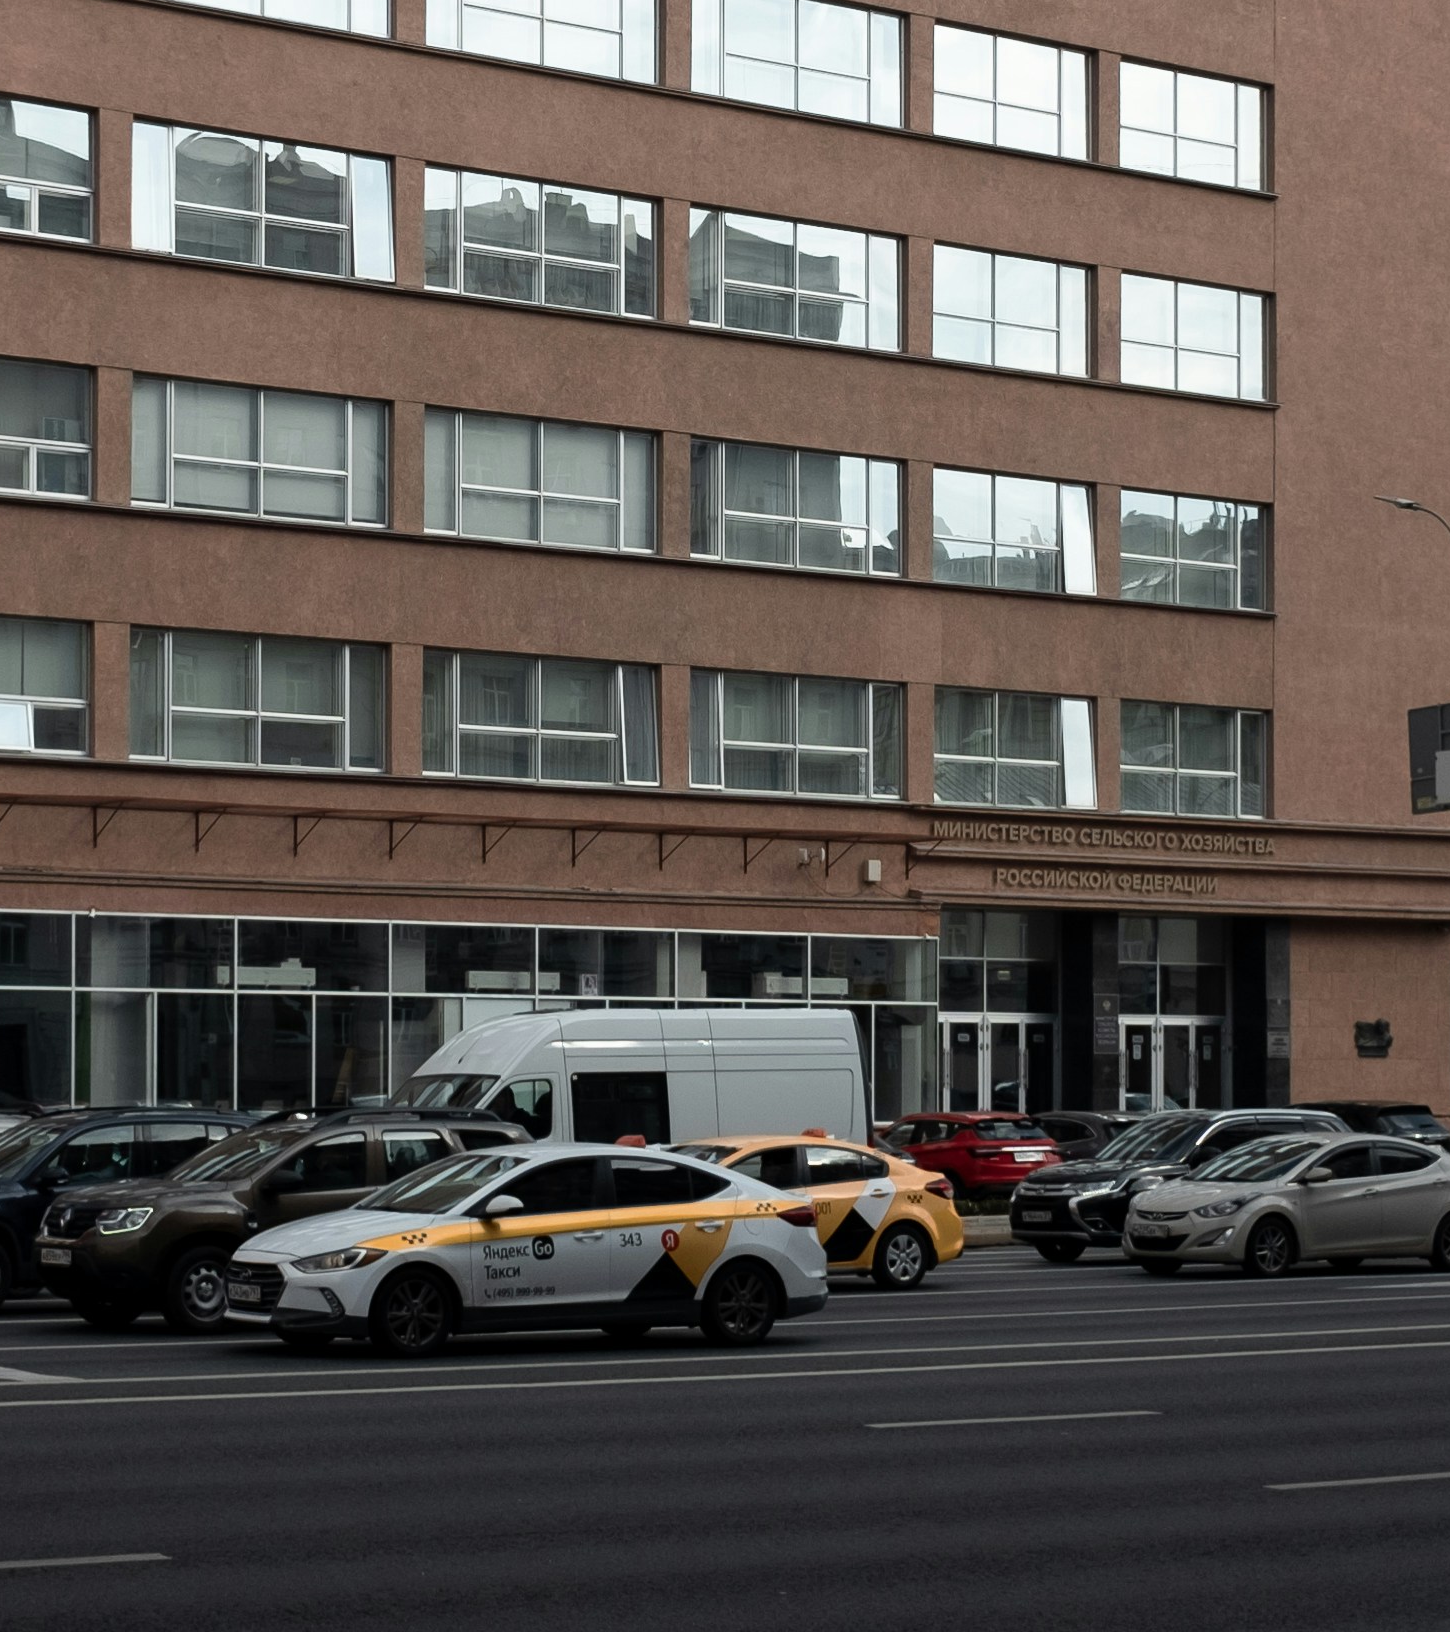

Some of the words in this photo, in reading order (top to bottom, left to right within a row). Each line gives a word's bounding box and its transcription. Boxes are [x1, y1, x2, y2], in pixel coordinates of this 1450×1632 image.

[933, 821, 1076, 845] МИНИСТЕРСТВО
[1080, 827, 1175, 849] СЕЛЬСКОГО
[1181, 832, 1276, 855] ХОЗЯЙСТВА
[997, 868, 1114, 889] РОССИЙСКОЙ
[1118, 874, 1219, 894] ФЕДЕРАЦИИ
[619, 1233, 642, 1247] 343
[483, 1244, 530, 1261] Яндекс
[534, 1239, 552, 1255] Go
[484, 1265, 521, 1280] Такси
[493, 1289, 514, 1299] (495)
